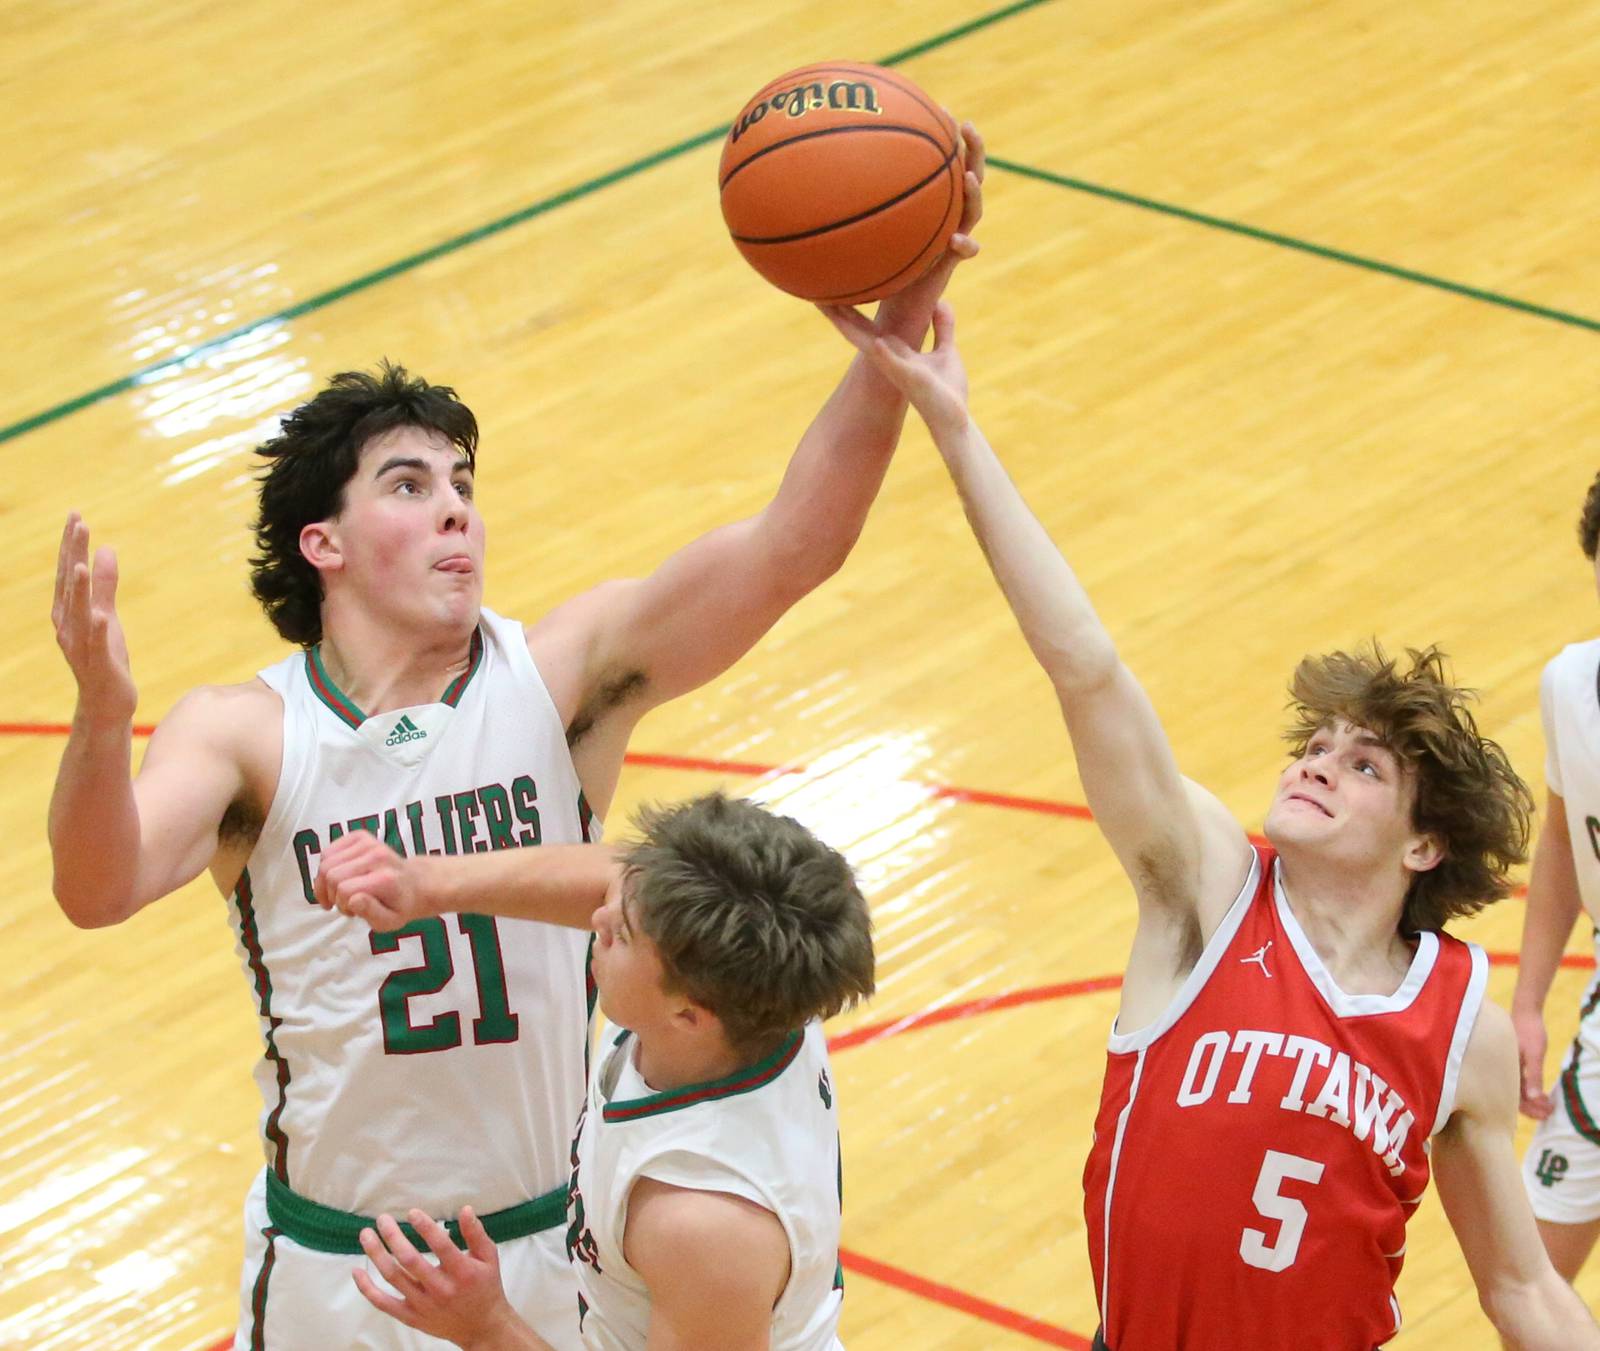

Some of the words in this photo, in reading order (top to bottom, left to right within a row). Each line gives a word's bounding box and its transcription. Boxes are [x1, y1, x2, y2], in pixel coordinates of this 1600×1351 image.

[732, 80, 883, 144] Wilson
[386, 730, 427, 746] adidas
[292, 775, 542, 905] CALIERS
[369, 911, 519, 1055] 21
[1176, 1030, 1415, 1177] OTTAWA
[1239, 1149, 1325, 1273] 5
